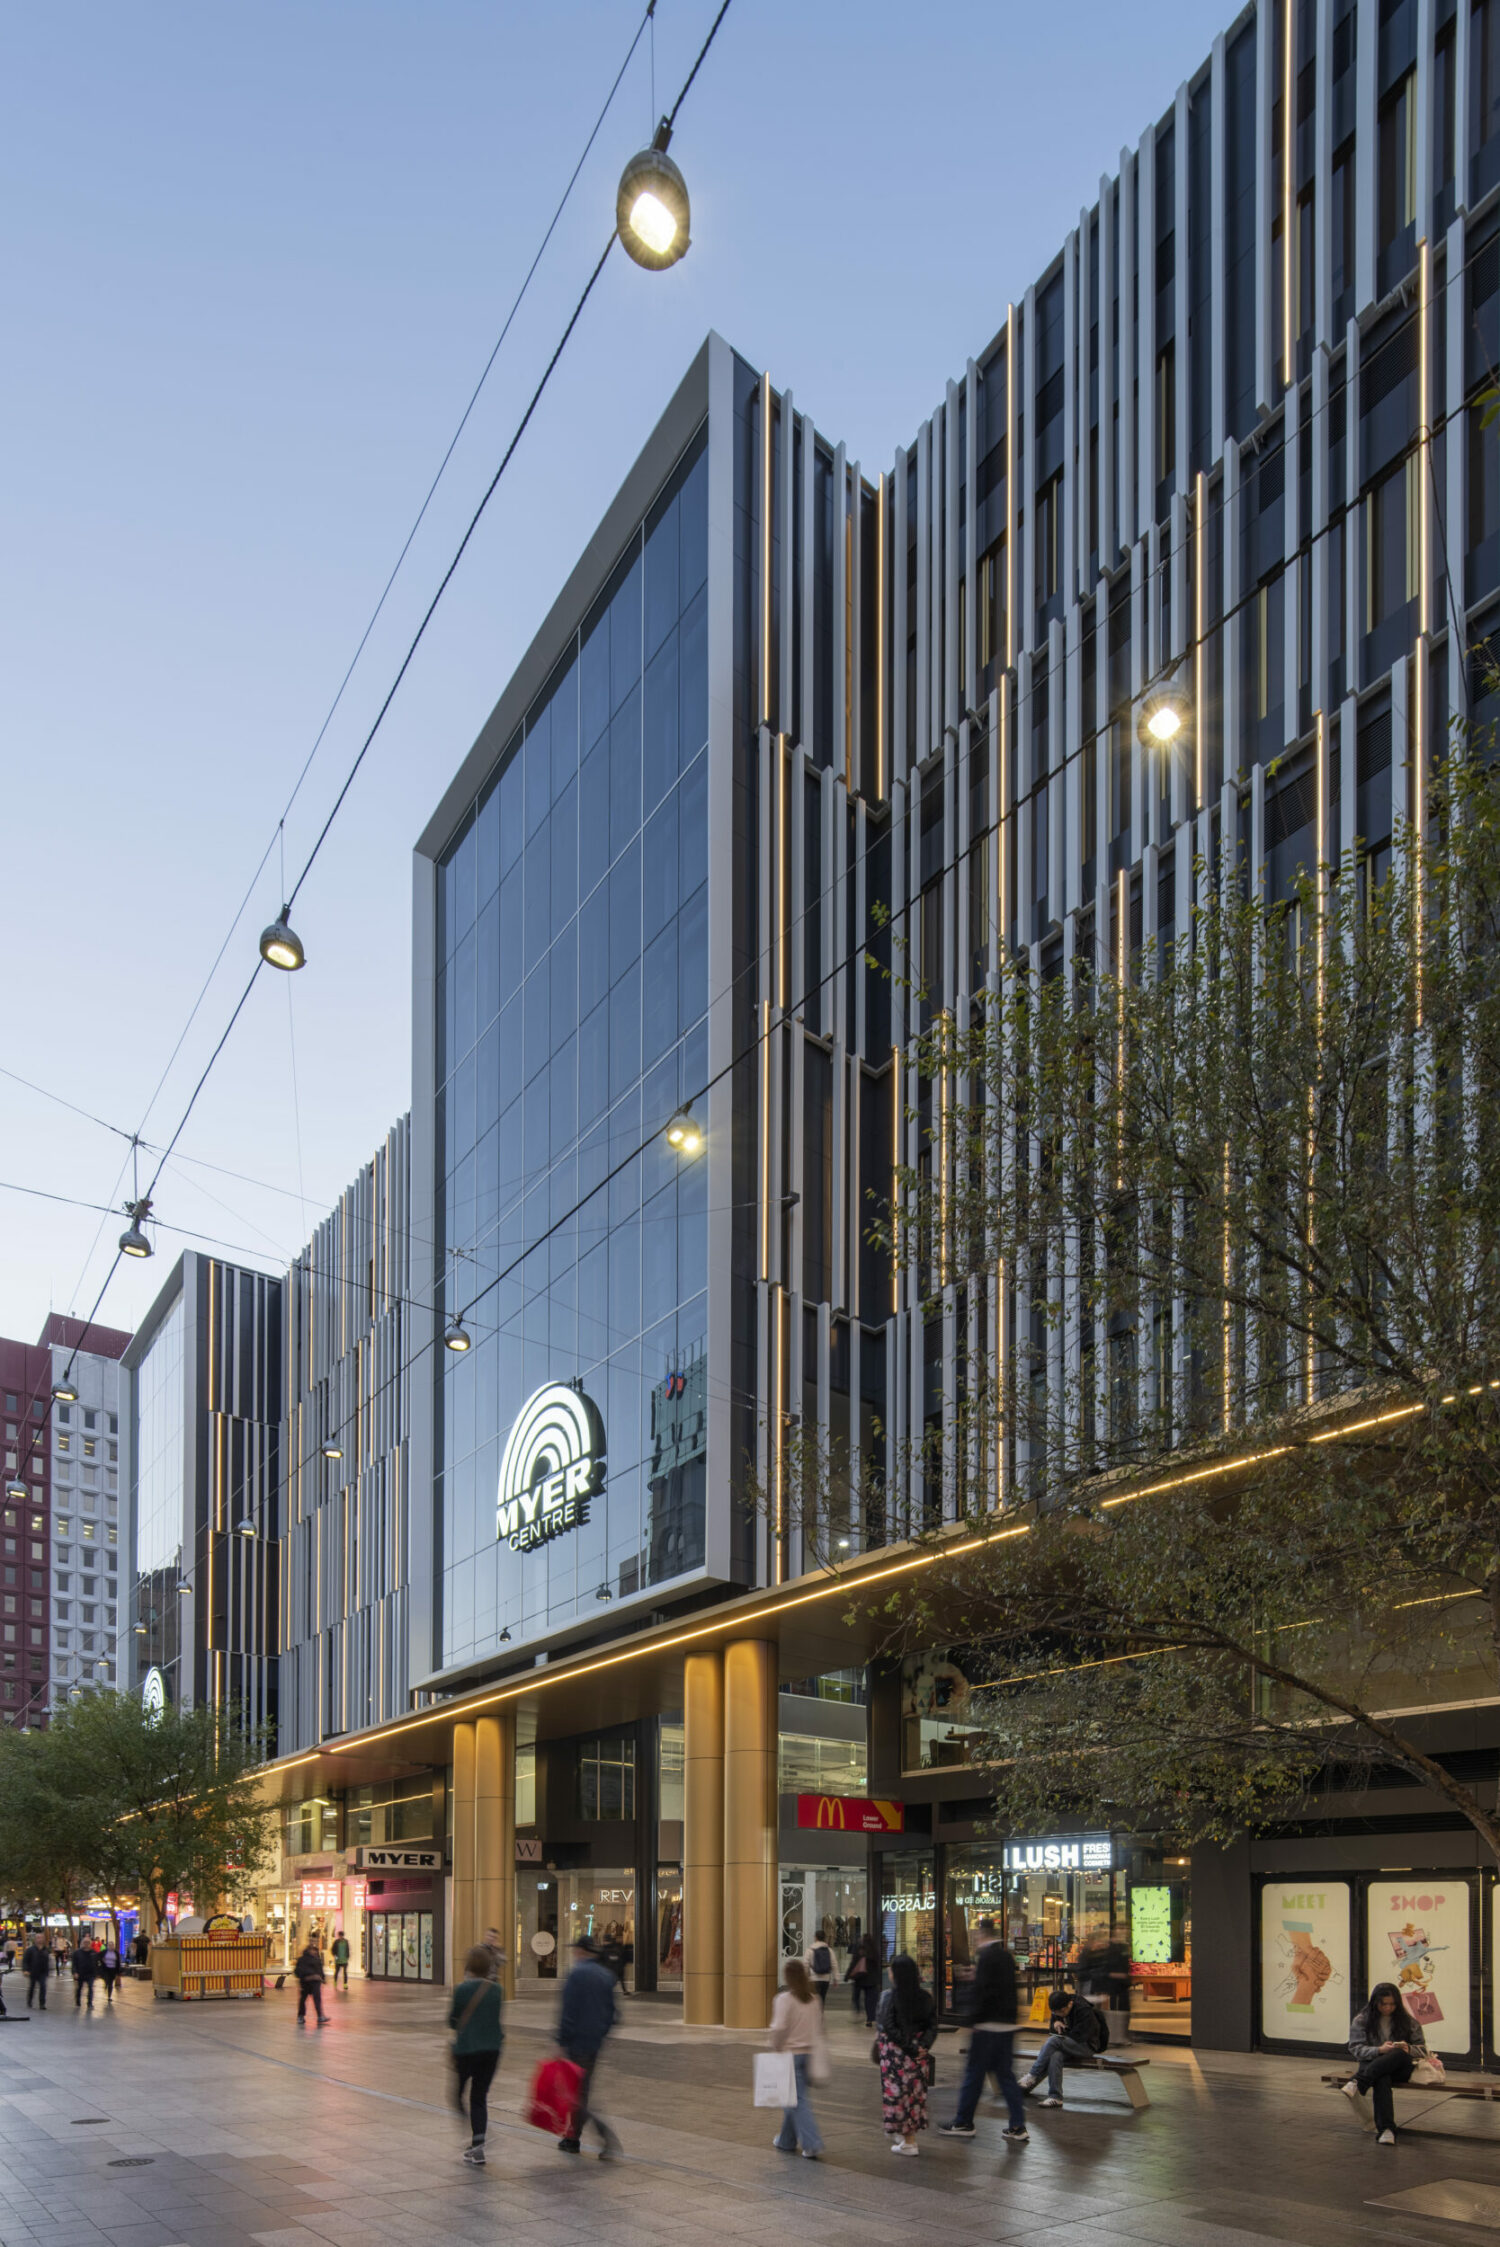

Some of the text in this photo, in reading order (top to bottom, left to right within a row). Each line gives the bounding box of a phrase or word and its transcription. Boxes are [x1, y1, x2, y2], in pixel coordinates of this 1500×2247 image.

[496, 1457, 591, 1540] MYER
[509, 1501, 576, 1551] CENTRE
[368, 1852, 435, 1866] MYER
[1012, 1844, 1079, 1869] LUSH
[1282, 1894, 1327, 1909] MEET
[1390, 1895, 1446, 1911] SHOP
